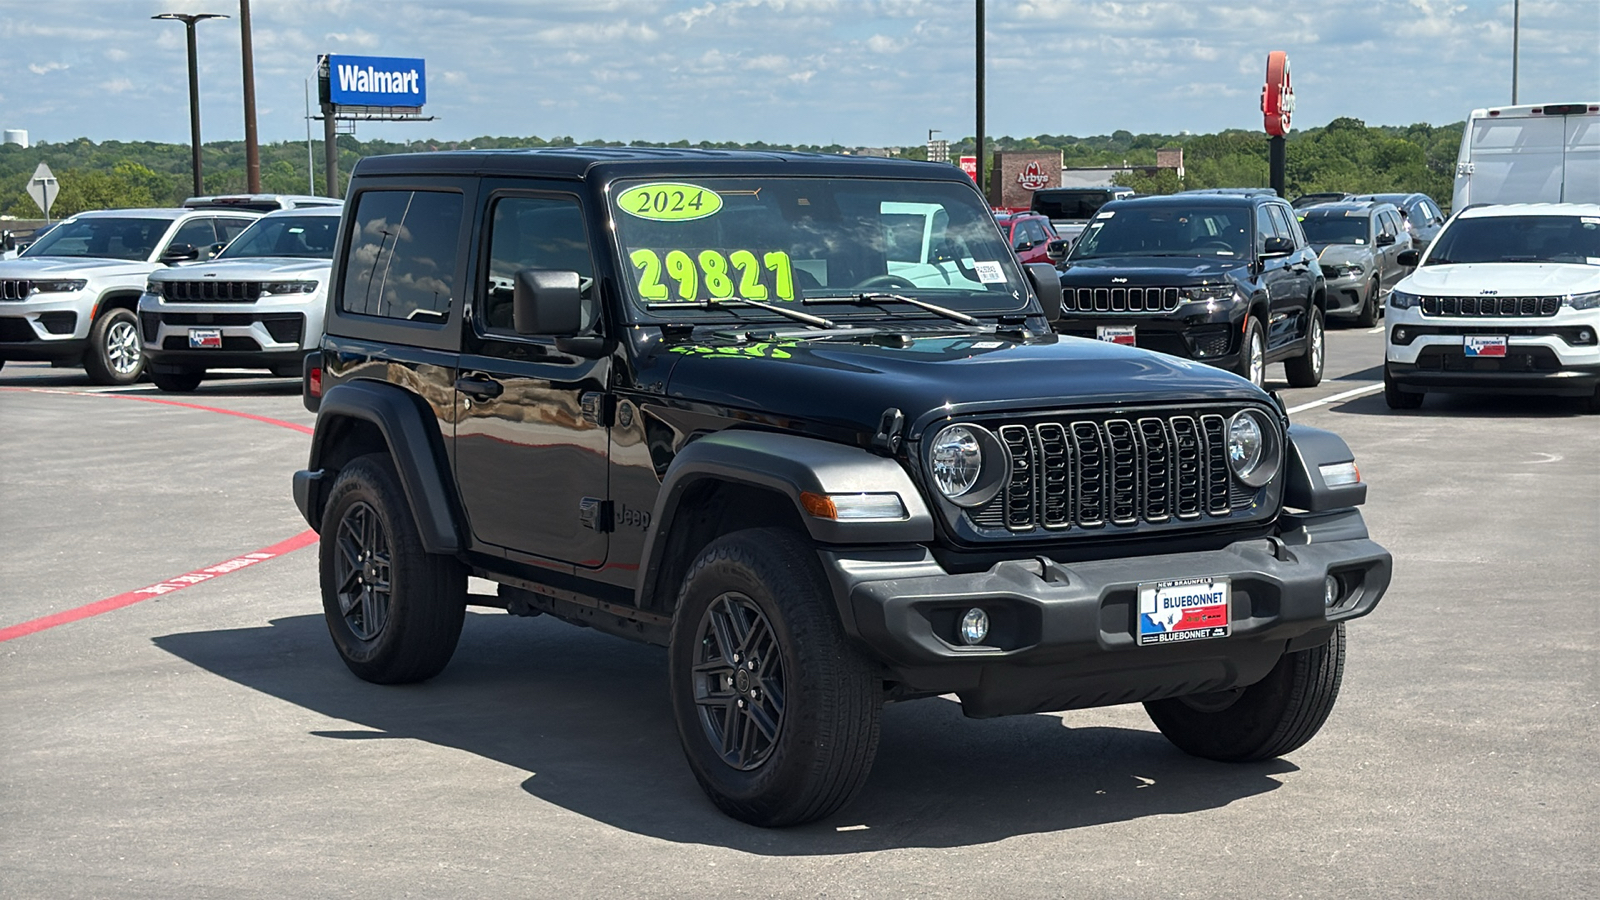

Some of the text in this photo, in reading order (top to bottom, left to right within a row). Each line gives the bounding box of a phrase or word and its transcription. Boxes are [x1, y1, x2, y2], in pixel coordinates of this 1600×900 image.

[337, 64, 419, 94] Walmart
[1017, 171, 1049, 185] Arby's
[636, 189, 704, 213] 2024
[629, 249, 795, 301] 29827
[615, 503, 652, 532] Jeep
[1174, 578, 1212, 586] BRAUNFELS
[1163, 592, 1223, 609] BLUEBONNET
[1159, 629, 1211, 642] BLUEBONNET
